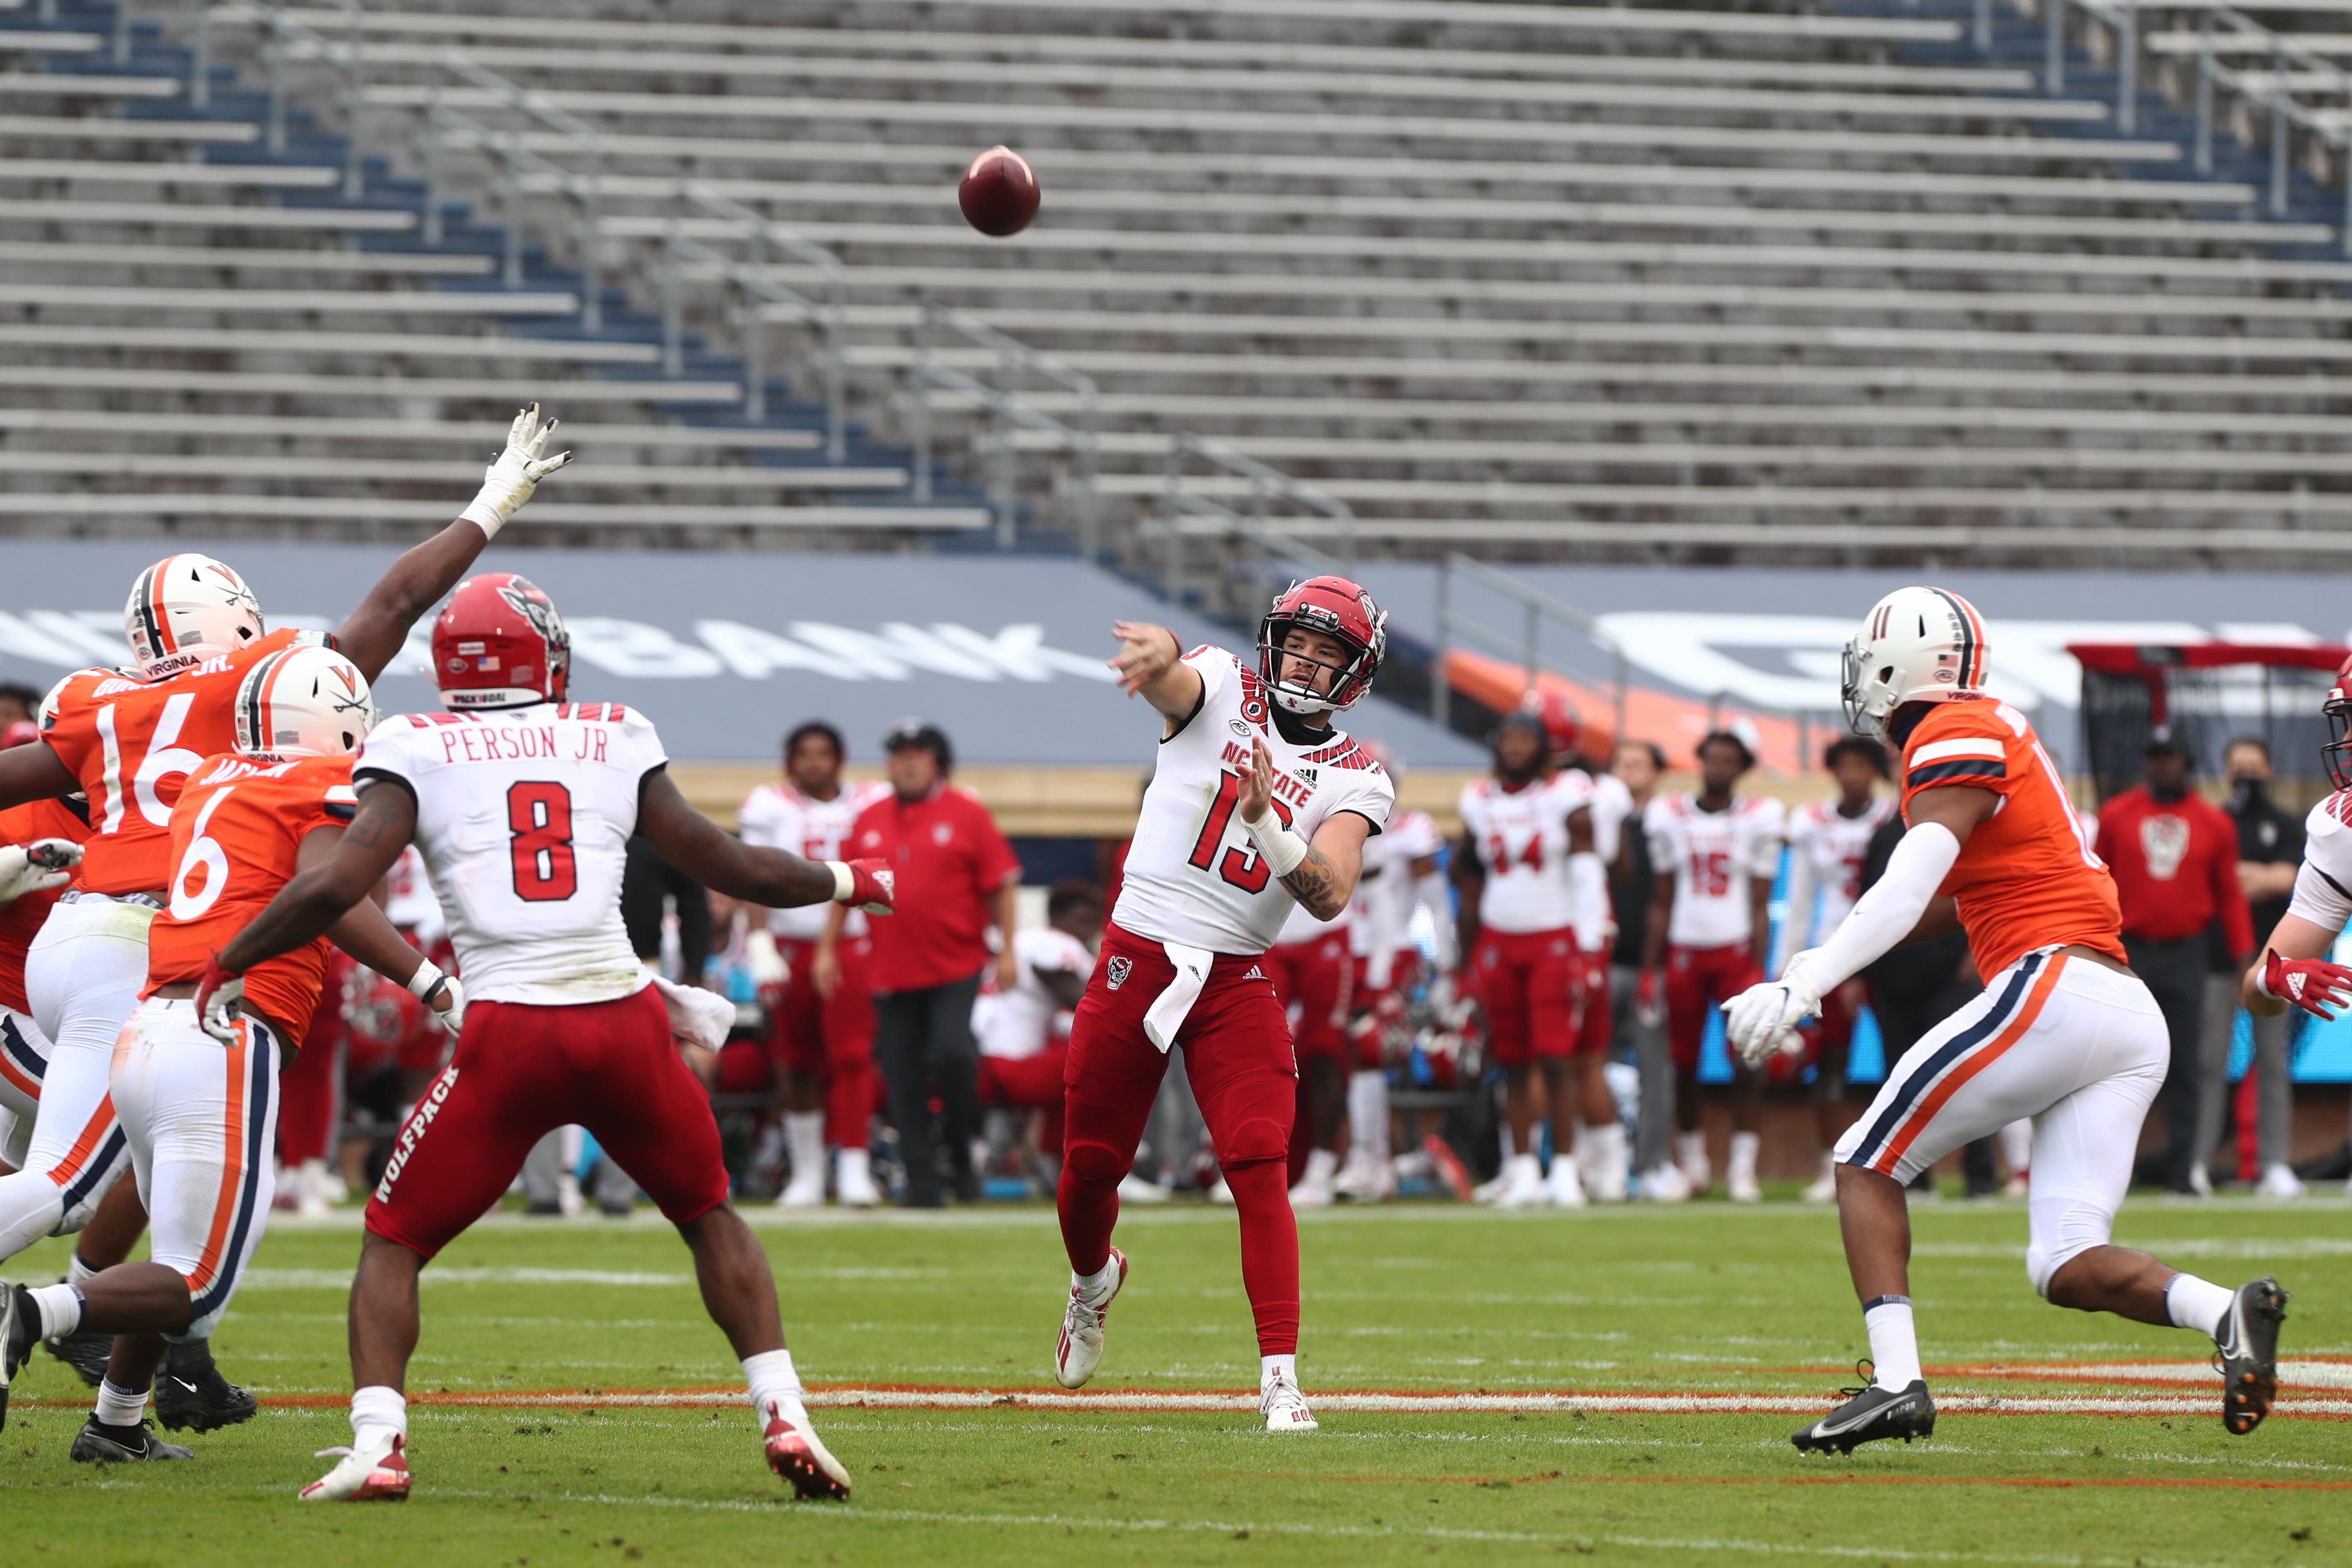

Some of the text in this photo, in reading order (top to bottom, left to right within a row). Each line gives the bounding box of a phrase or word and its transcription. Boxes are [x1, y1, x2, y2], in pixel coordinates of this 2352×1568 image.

[1310, 609, 1330, 618] ACC
[1872, 604, 1893, 642] 11
[145, 655, 201, 677] VIRGINIA
[191, 654, 234, 676] JR.
[440, 726, 608, 763] PERSON JR
[1232, 723, 1249, 734] ACC
[96, 693, 206, 834] 16
[1220, 740, 1314, 810] NC TATE
[1293, 769, 1318, 789] adidas
[507, 780, 578, 902] 8
[1187, 768, 1294, 895] 13
[167, 786, 236, 921] 6
[375, 1063, 460, 1205] WOLFPACK
